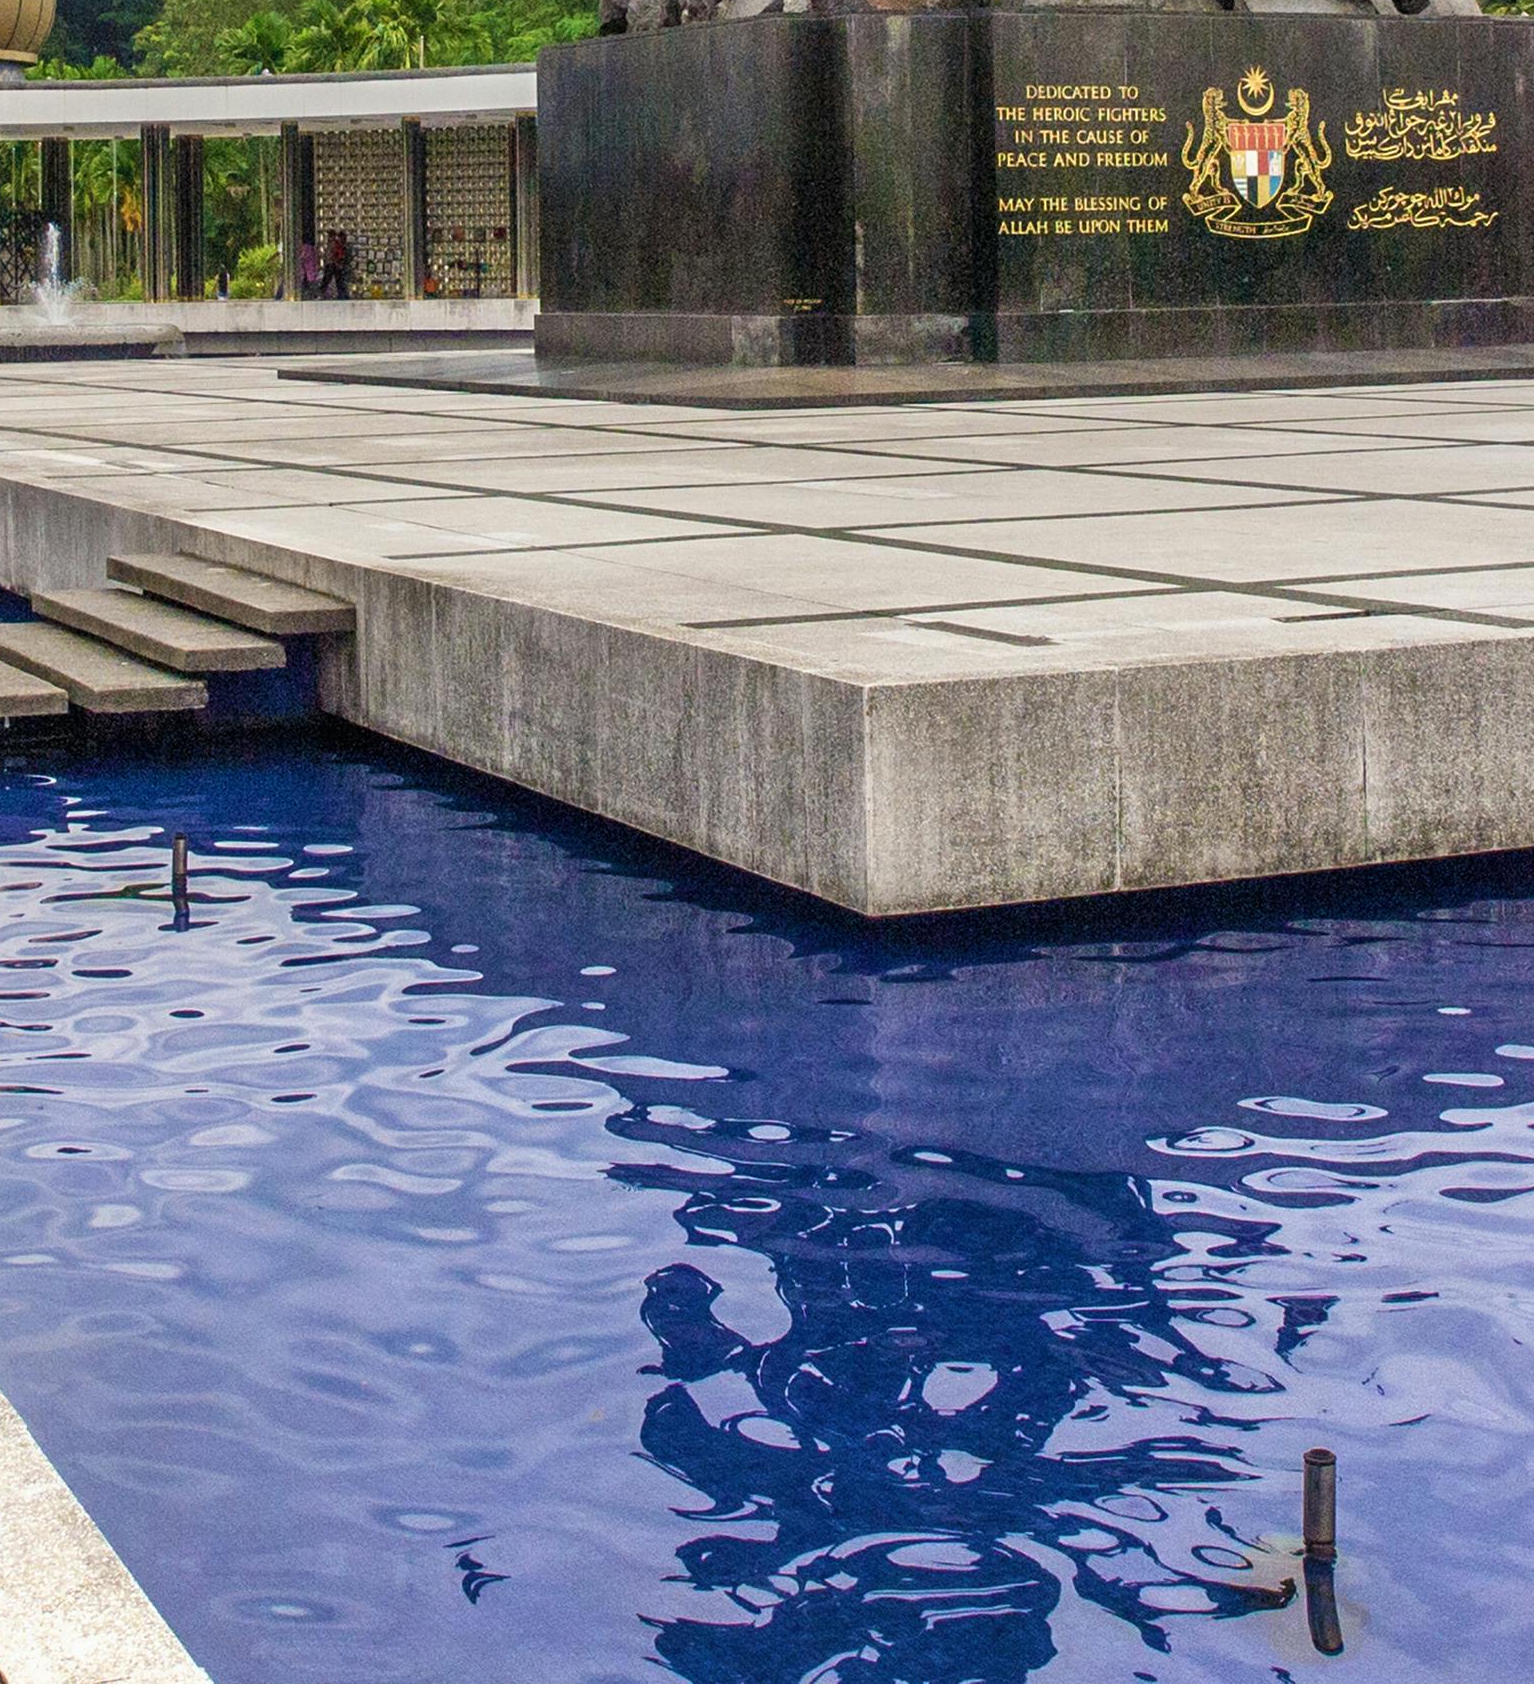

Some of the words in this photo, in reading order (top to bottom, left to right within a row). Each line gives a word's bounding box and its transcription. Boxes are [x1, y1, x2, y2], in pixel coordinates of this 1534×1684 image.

[1025, 85, 1112, 100] DEDICATED
[1118, 86, 1139, 100] TO
[995, 107, 1026, 121] THE
[1032, 107, 1091, 122] HEROIC
[1097, 107, 1167, 122] FIGHTERS
[1014, 130, 1033, 144] IN
[1039, 130, 1070, 144] THE
[1076, 129, 1124, 144] CAUSE
[1130, 130, 1150, 144] OF
[997, 152, 1047, 167] PEACE
[1053, 152, 1090, 167] AND
[1096, 152, 1168, 167] FREEDOM
[998, 198, 1035, 212] MAY
[1039, 197, 1069, 212] THE
[1074, 197, 1141, 211] BLESSING
[1148, 196, 1168, 210] OF
[997, 220, 1048, 235] ALLAH
[1055, 220, 1073, 234] BE
[1079, 219, 1120, 234] UPON
[1126, 219, 1169, 233] THEM
